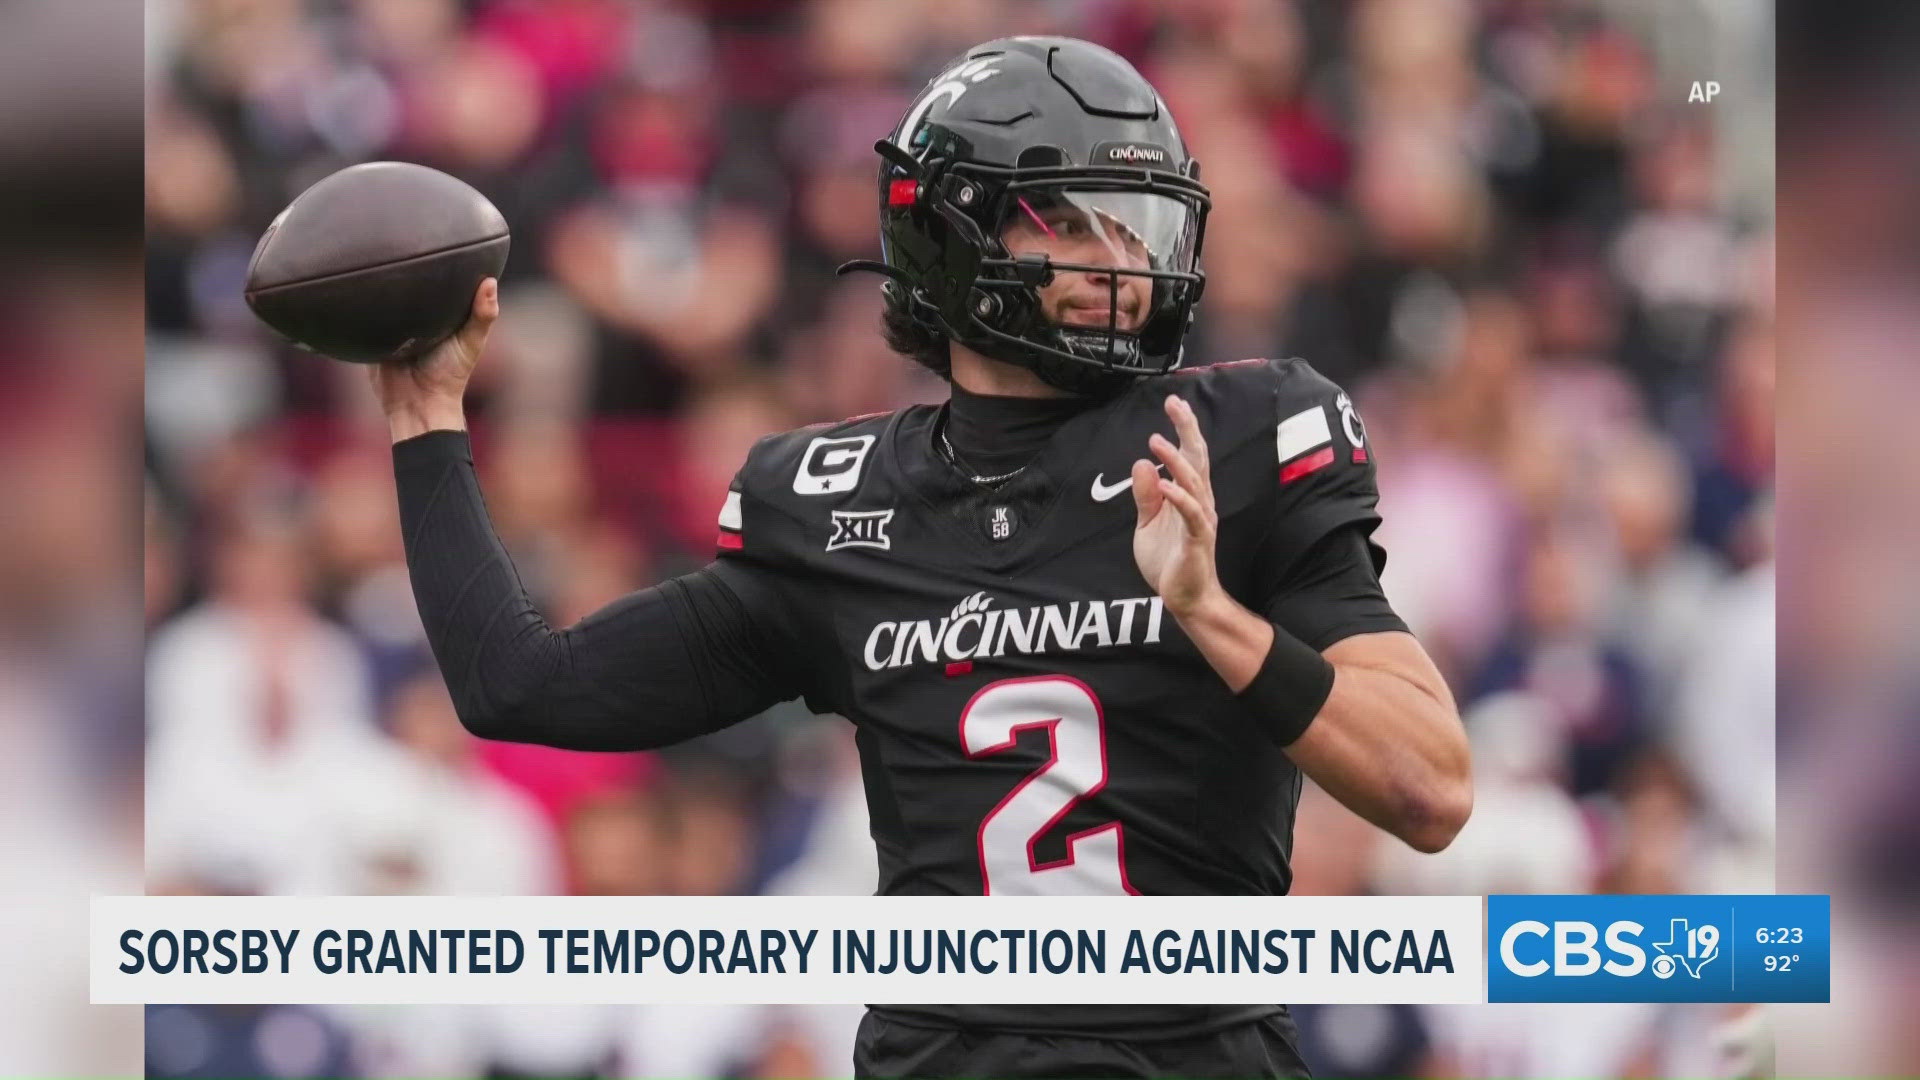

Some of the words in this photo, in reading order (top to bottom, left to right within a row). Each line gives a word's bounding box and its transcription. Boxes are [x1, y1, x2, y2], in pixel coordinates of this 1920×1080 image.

[1109, 145, 1163, 162] CINCINNATI
[807, 440, 866, 477] C
[831, 515, 889, 546] XII
[991, 507, 1008, 523] JK
[992, 521, 1010, 539] 58
[864, 591, 1163, 671] CINCINNATI
[958, 673, 1143, 895] 2
